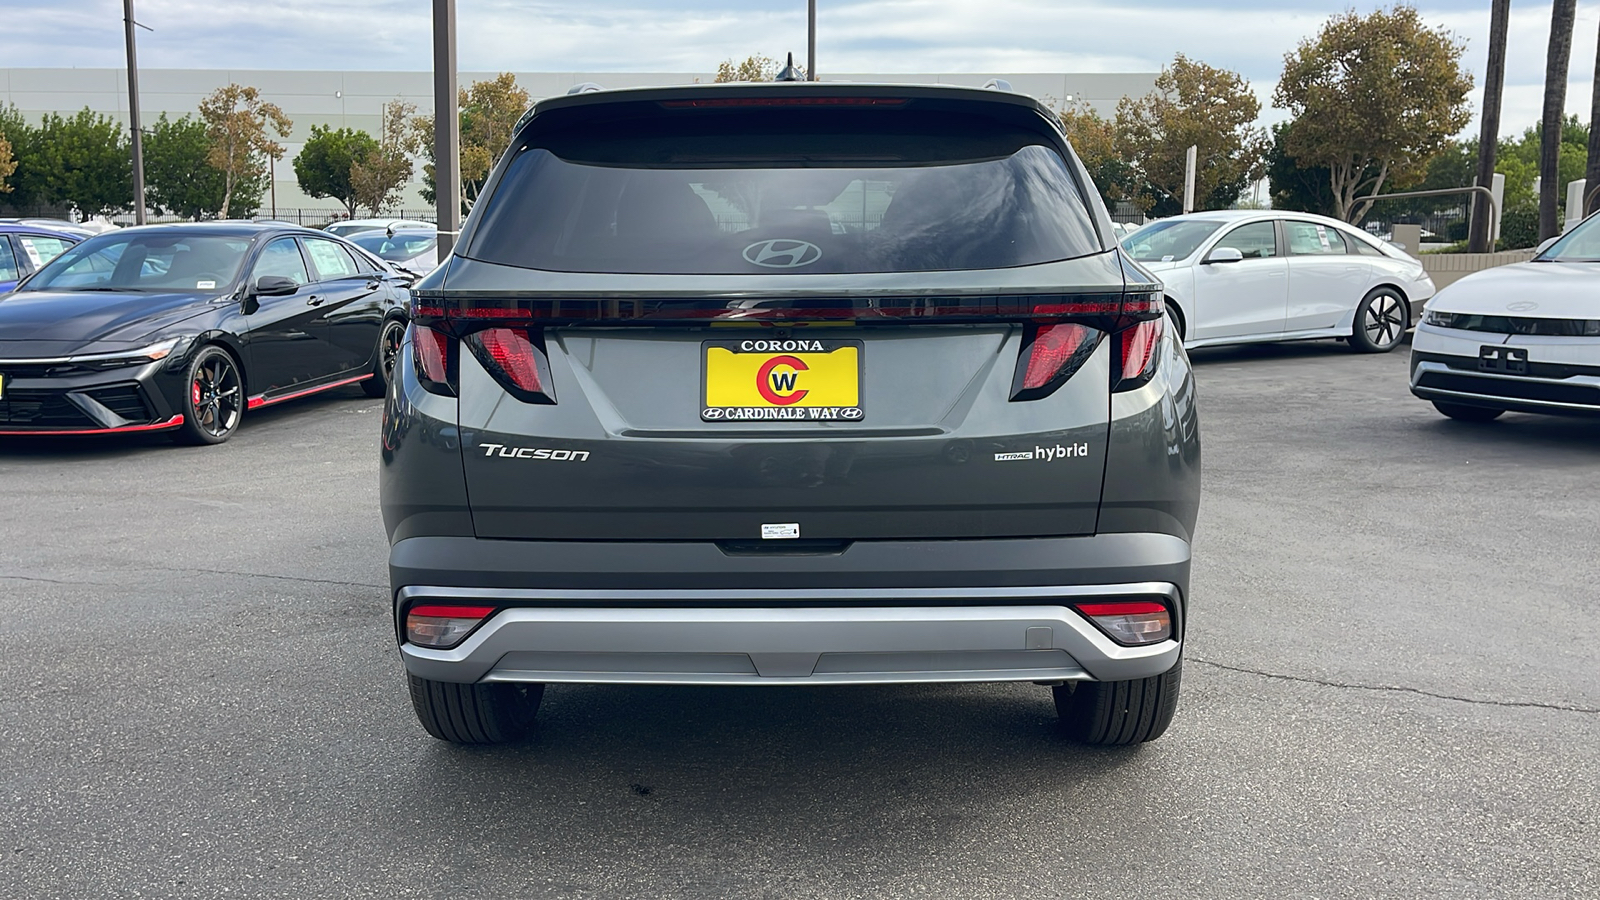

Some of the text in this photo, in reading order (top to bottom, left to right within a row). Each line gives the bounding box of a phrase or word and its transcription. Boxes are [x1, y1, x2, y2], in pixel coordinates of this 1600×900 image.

[740, 340, 824, 352] CORONA
[725, 407, 840, 420] CARDINALE WAY
[1035, 442, 1088, 462] hybrid
